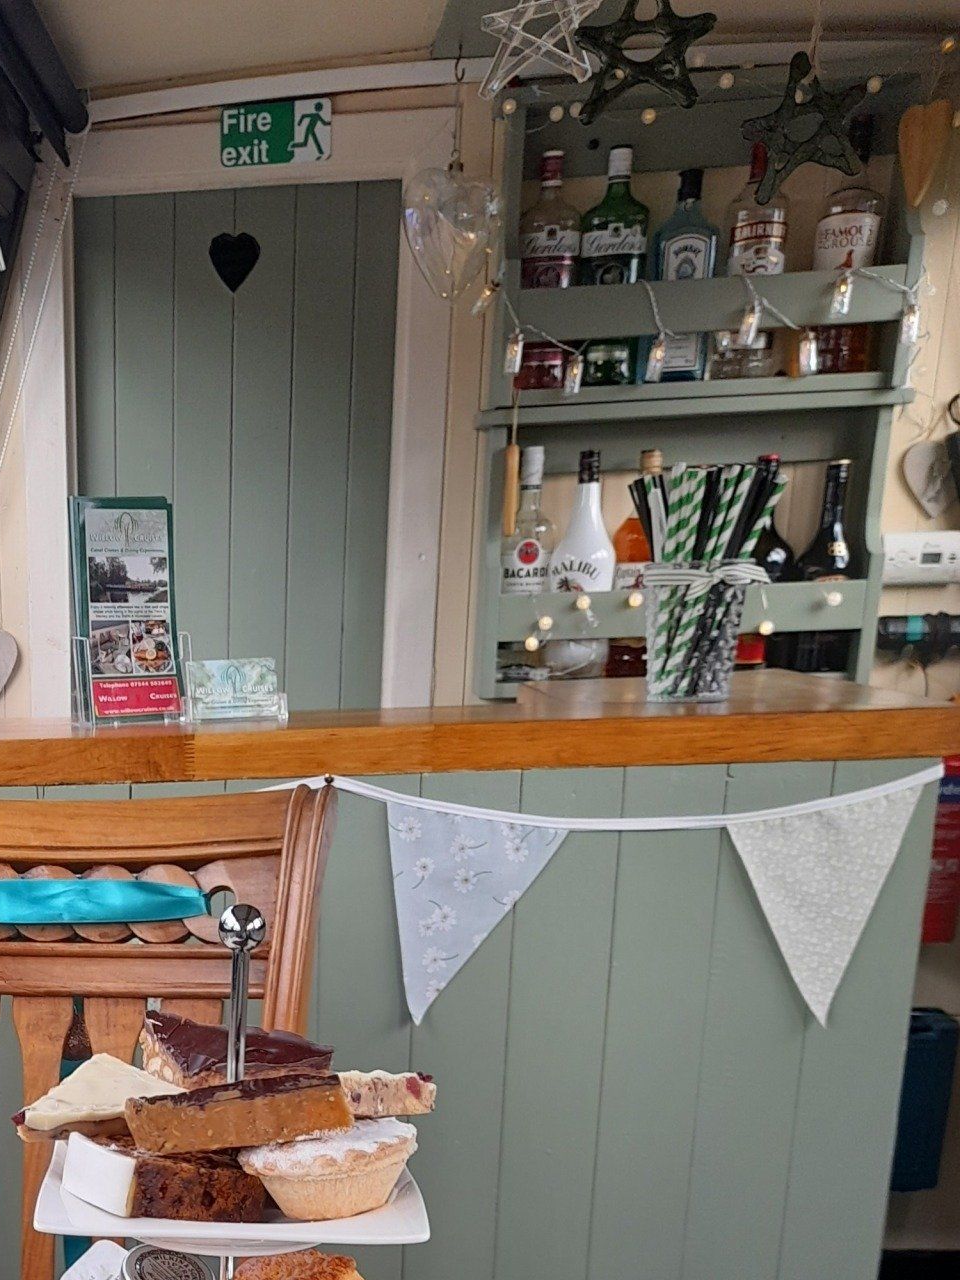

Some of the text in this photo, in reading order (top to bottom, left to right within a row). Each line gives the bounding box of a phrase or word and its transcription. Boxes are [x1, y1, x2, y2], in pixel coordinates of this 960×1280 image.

[222, 108, 272, 134] Fire
[222, 138, 269, 167] exit
[503, 566, 549, 579] BACARDI
[551, 560, 600, 580] MALIBU
